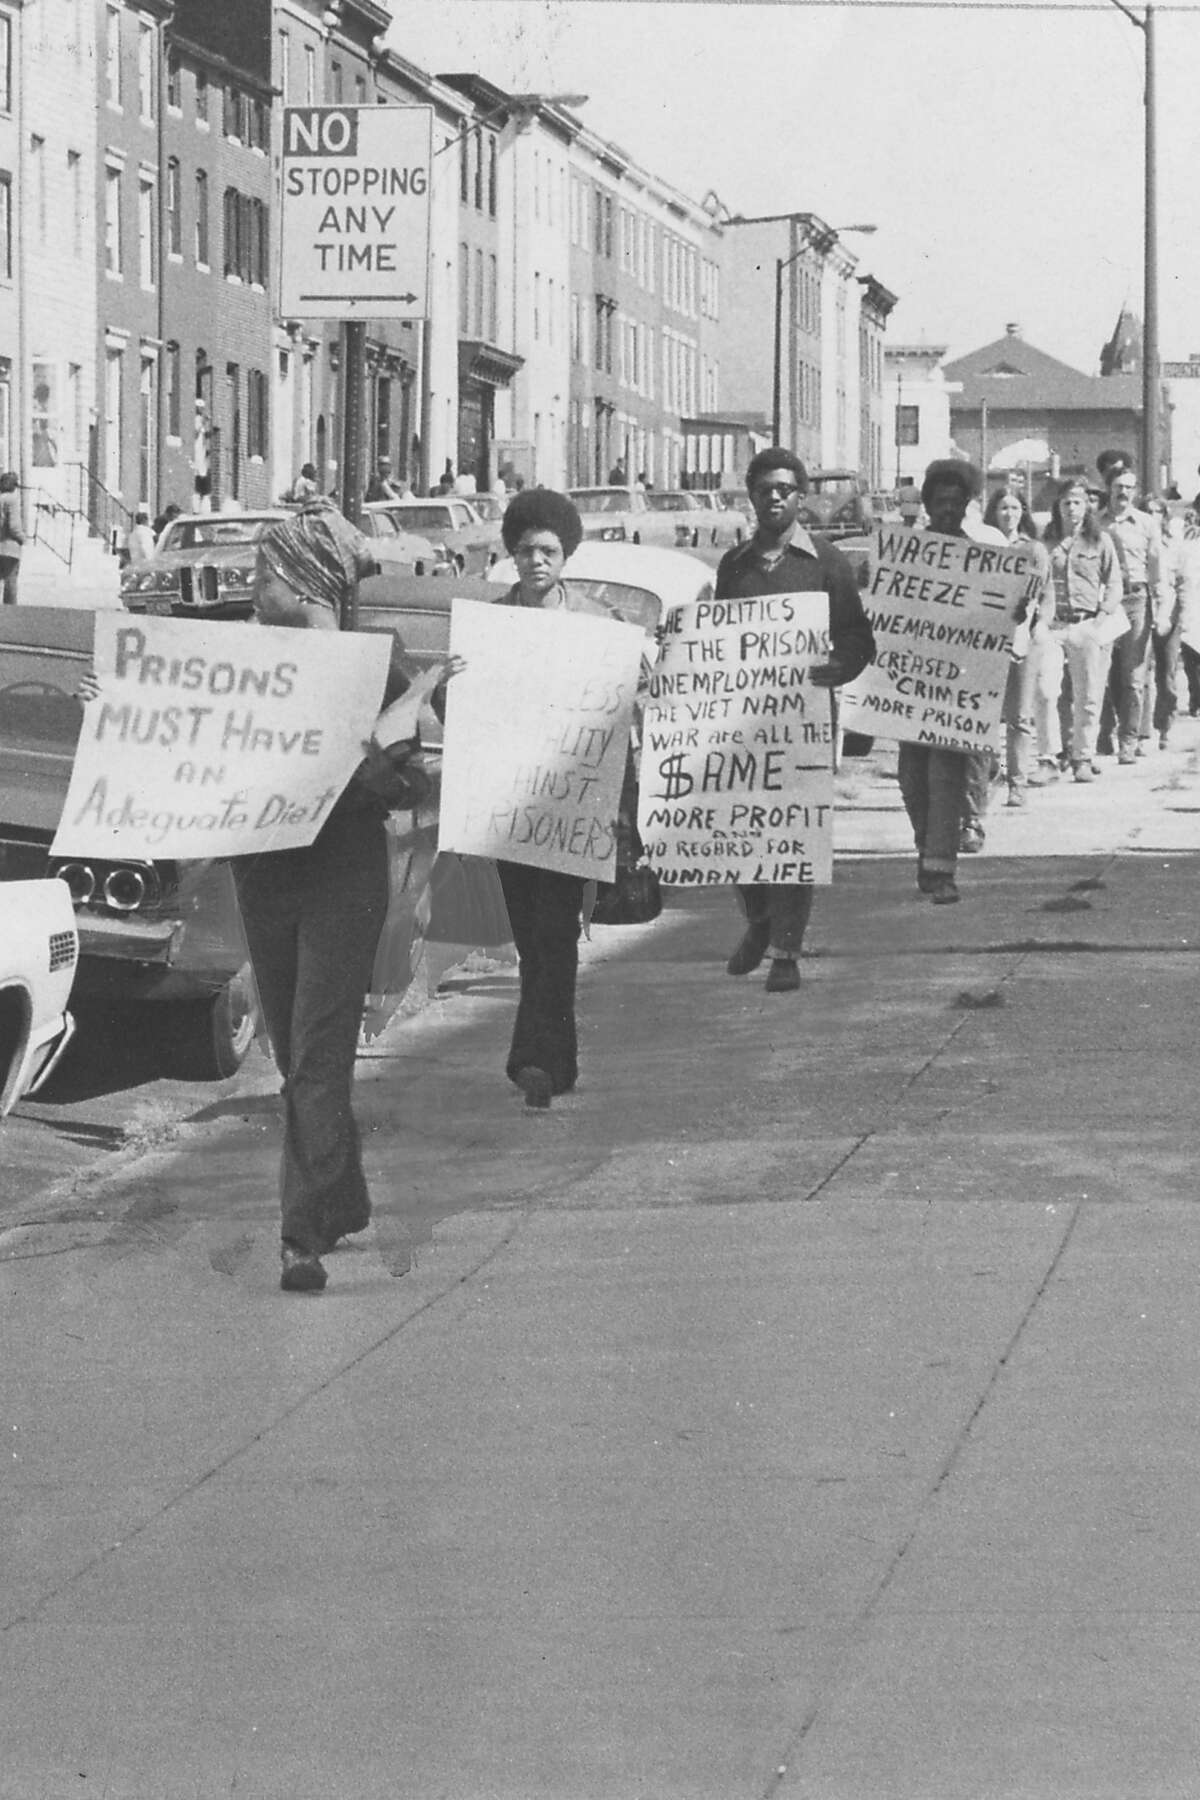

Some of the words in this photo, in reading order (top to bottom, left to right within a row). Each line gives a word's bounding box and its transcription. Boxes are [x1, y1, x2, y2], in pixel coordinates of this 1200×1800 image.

[289, 111, 350, 152] NO
[286, 167, 427, 196] STOPPING
[318, 206, 396, 233] ANY
[313, 244, 397, 272] TIME
[870, 567, 971, 608] FREEZE
[664, 608, 685, 634] HE
[696, 598, 796, 630] POLITICS
[115, 627, 298, 699] PRISONS
[681, 637, 726, 663] THE
[868, 650, 961, 680] CREASED
[650, 665, 806, 699] UNEMPLOYMEN
[650, 704, 677, 724] THE
[686, 697, 733, 721] VIET
[742, 692, 806, 718] NAM
[862, 694, 914, 719] MORE
[921, 707, 991, 735] PRISON
[96, 702, 213, 747] MUST
[650, 728, 699, 752] WAR
[708, 729, 745, 745] are
[754, 724, 793, 745] ALL
[802, 721, 832, 744] THE
[174, 761, 225, 785] AN
[255, 784, 339, 830] Diet
[646, 806, 716, 830] MORE
[730, 804, 830, 829] PROFIT
[645, 841, 667, 860] NO
[677, 840, 753, 859] REGARD
[767, 839, 805, 857] FOR
[753, 862, 815, 883] LIFE
